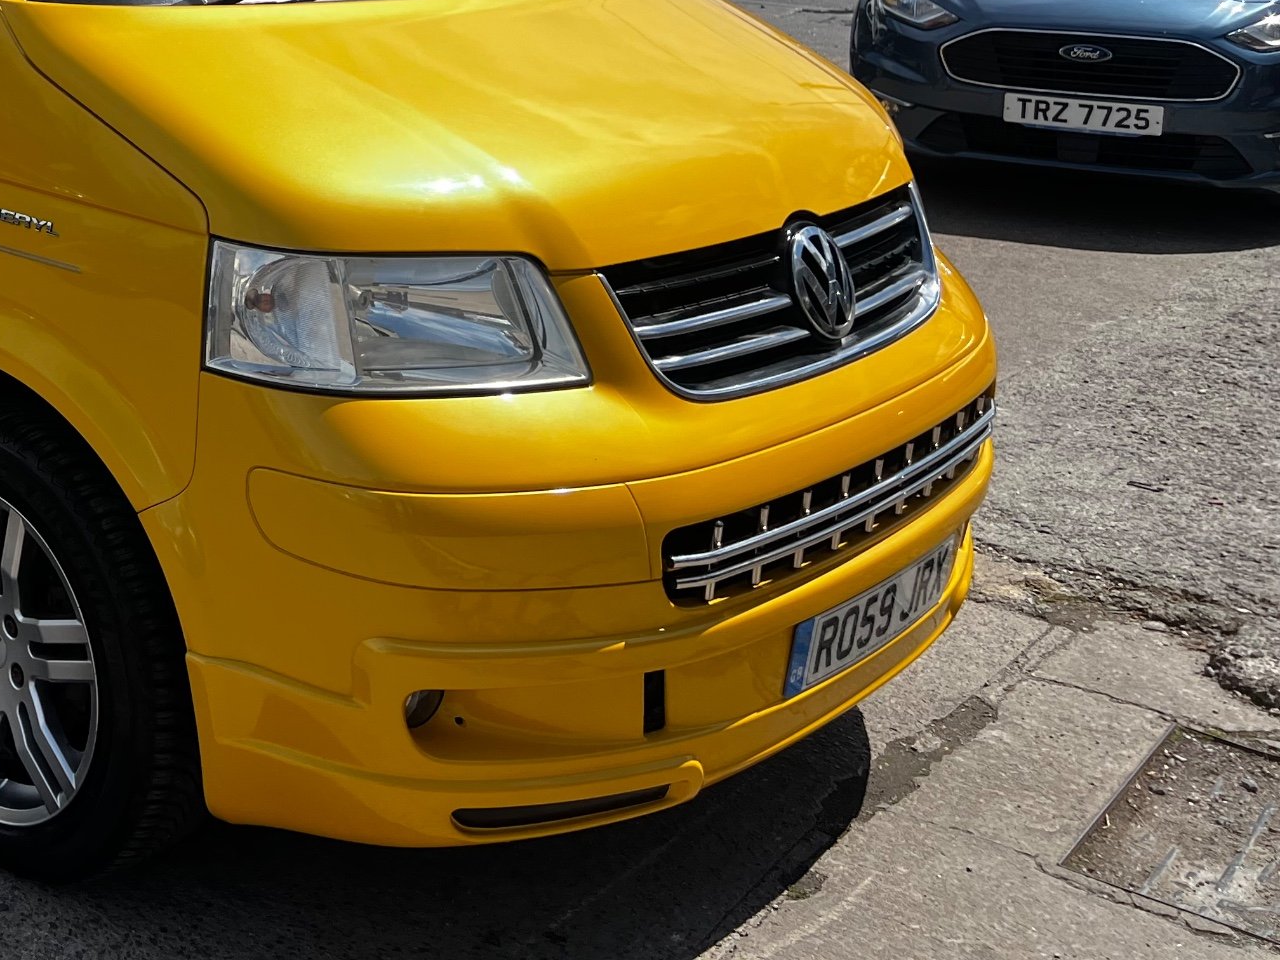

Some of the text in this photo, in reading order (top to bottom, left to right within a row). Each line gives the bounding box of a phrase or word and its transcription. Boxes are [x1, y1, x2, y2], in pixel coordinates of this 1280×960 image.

[1071, 46, 1100, 59] Ford
[1017, 97, 1150, 130] TRZ 7725
[813, 583, 897, 675] RO59
[790, 666, 803, 683] GB
